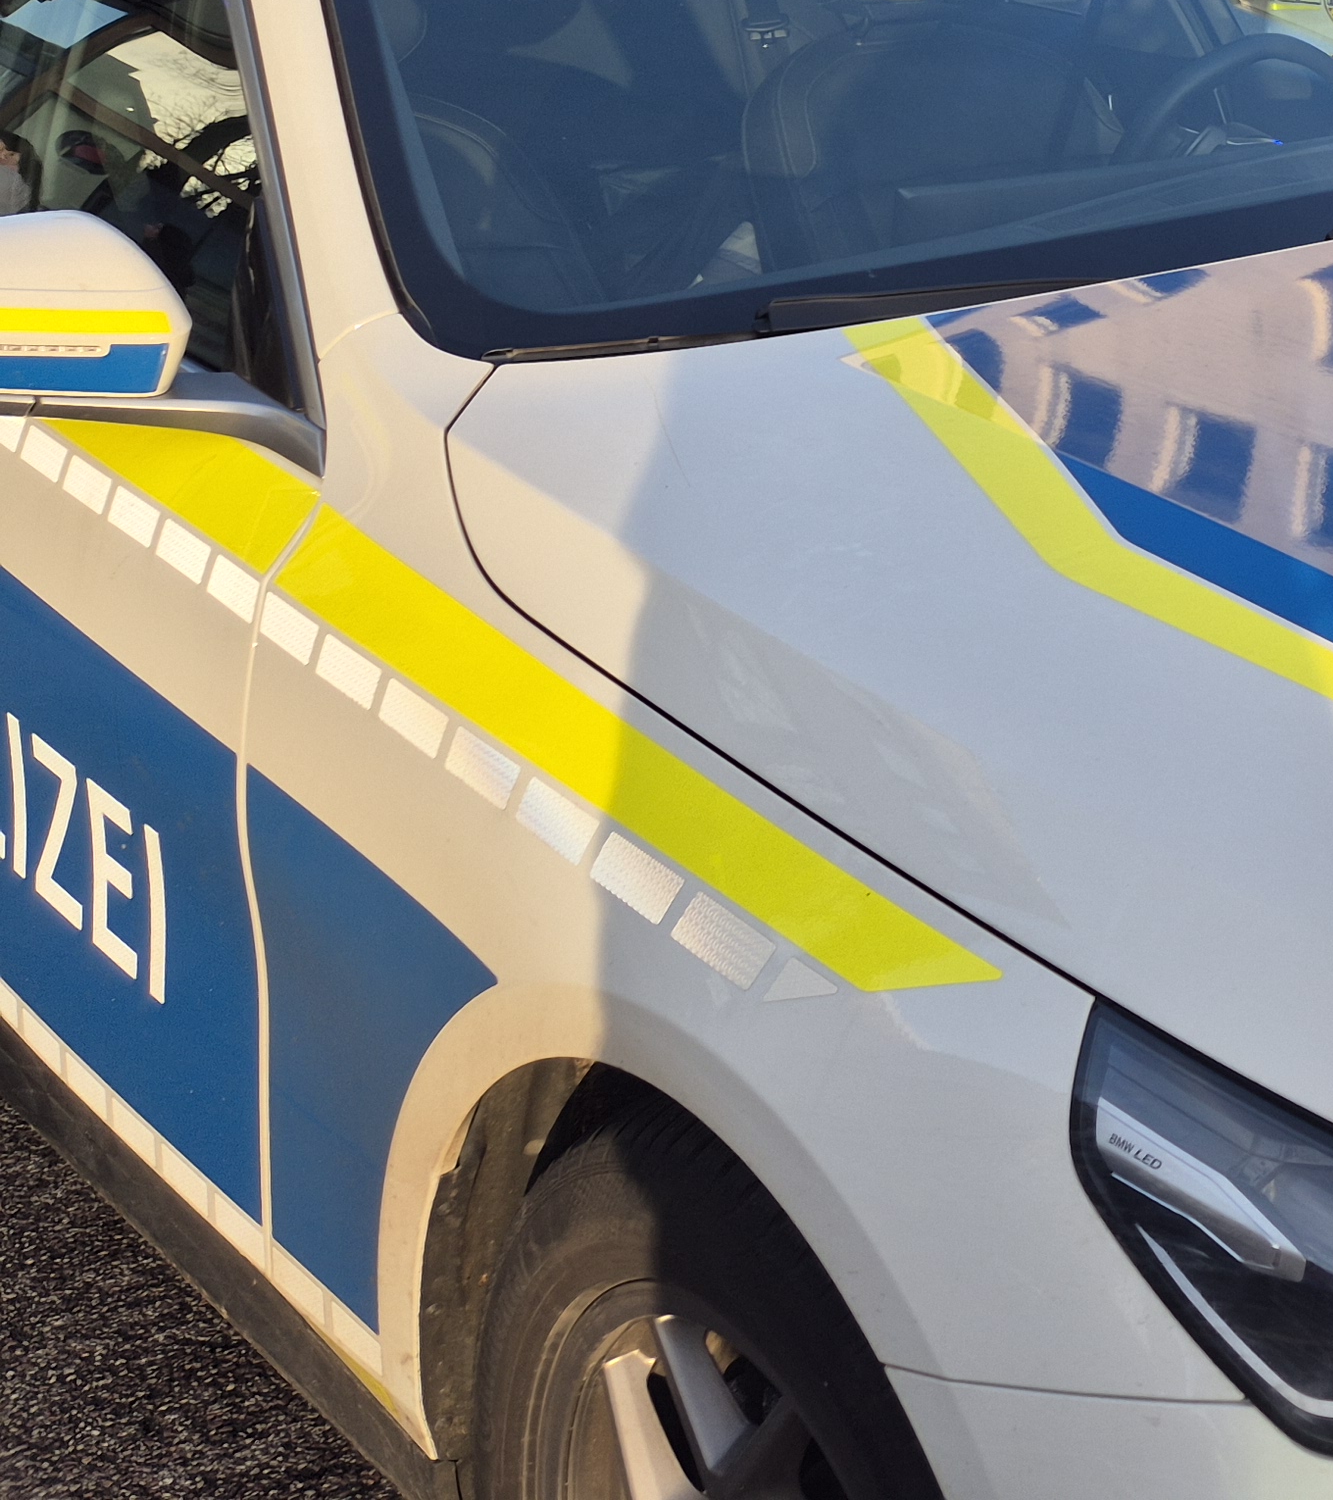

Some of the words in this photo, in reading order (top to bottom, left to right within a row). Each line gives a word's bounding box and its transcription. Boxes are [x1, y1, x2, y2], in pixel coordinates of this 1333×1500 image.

[0, 711, 167, 1005] IZEI
[1108, 1133, 1135, 1154] BMW
[1133, 1148, 1163, 1170] LED
